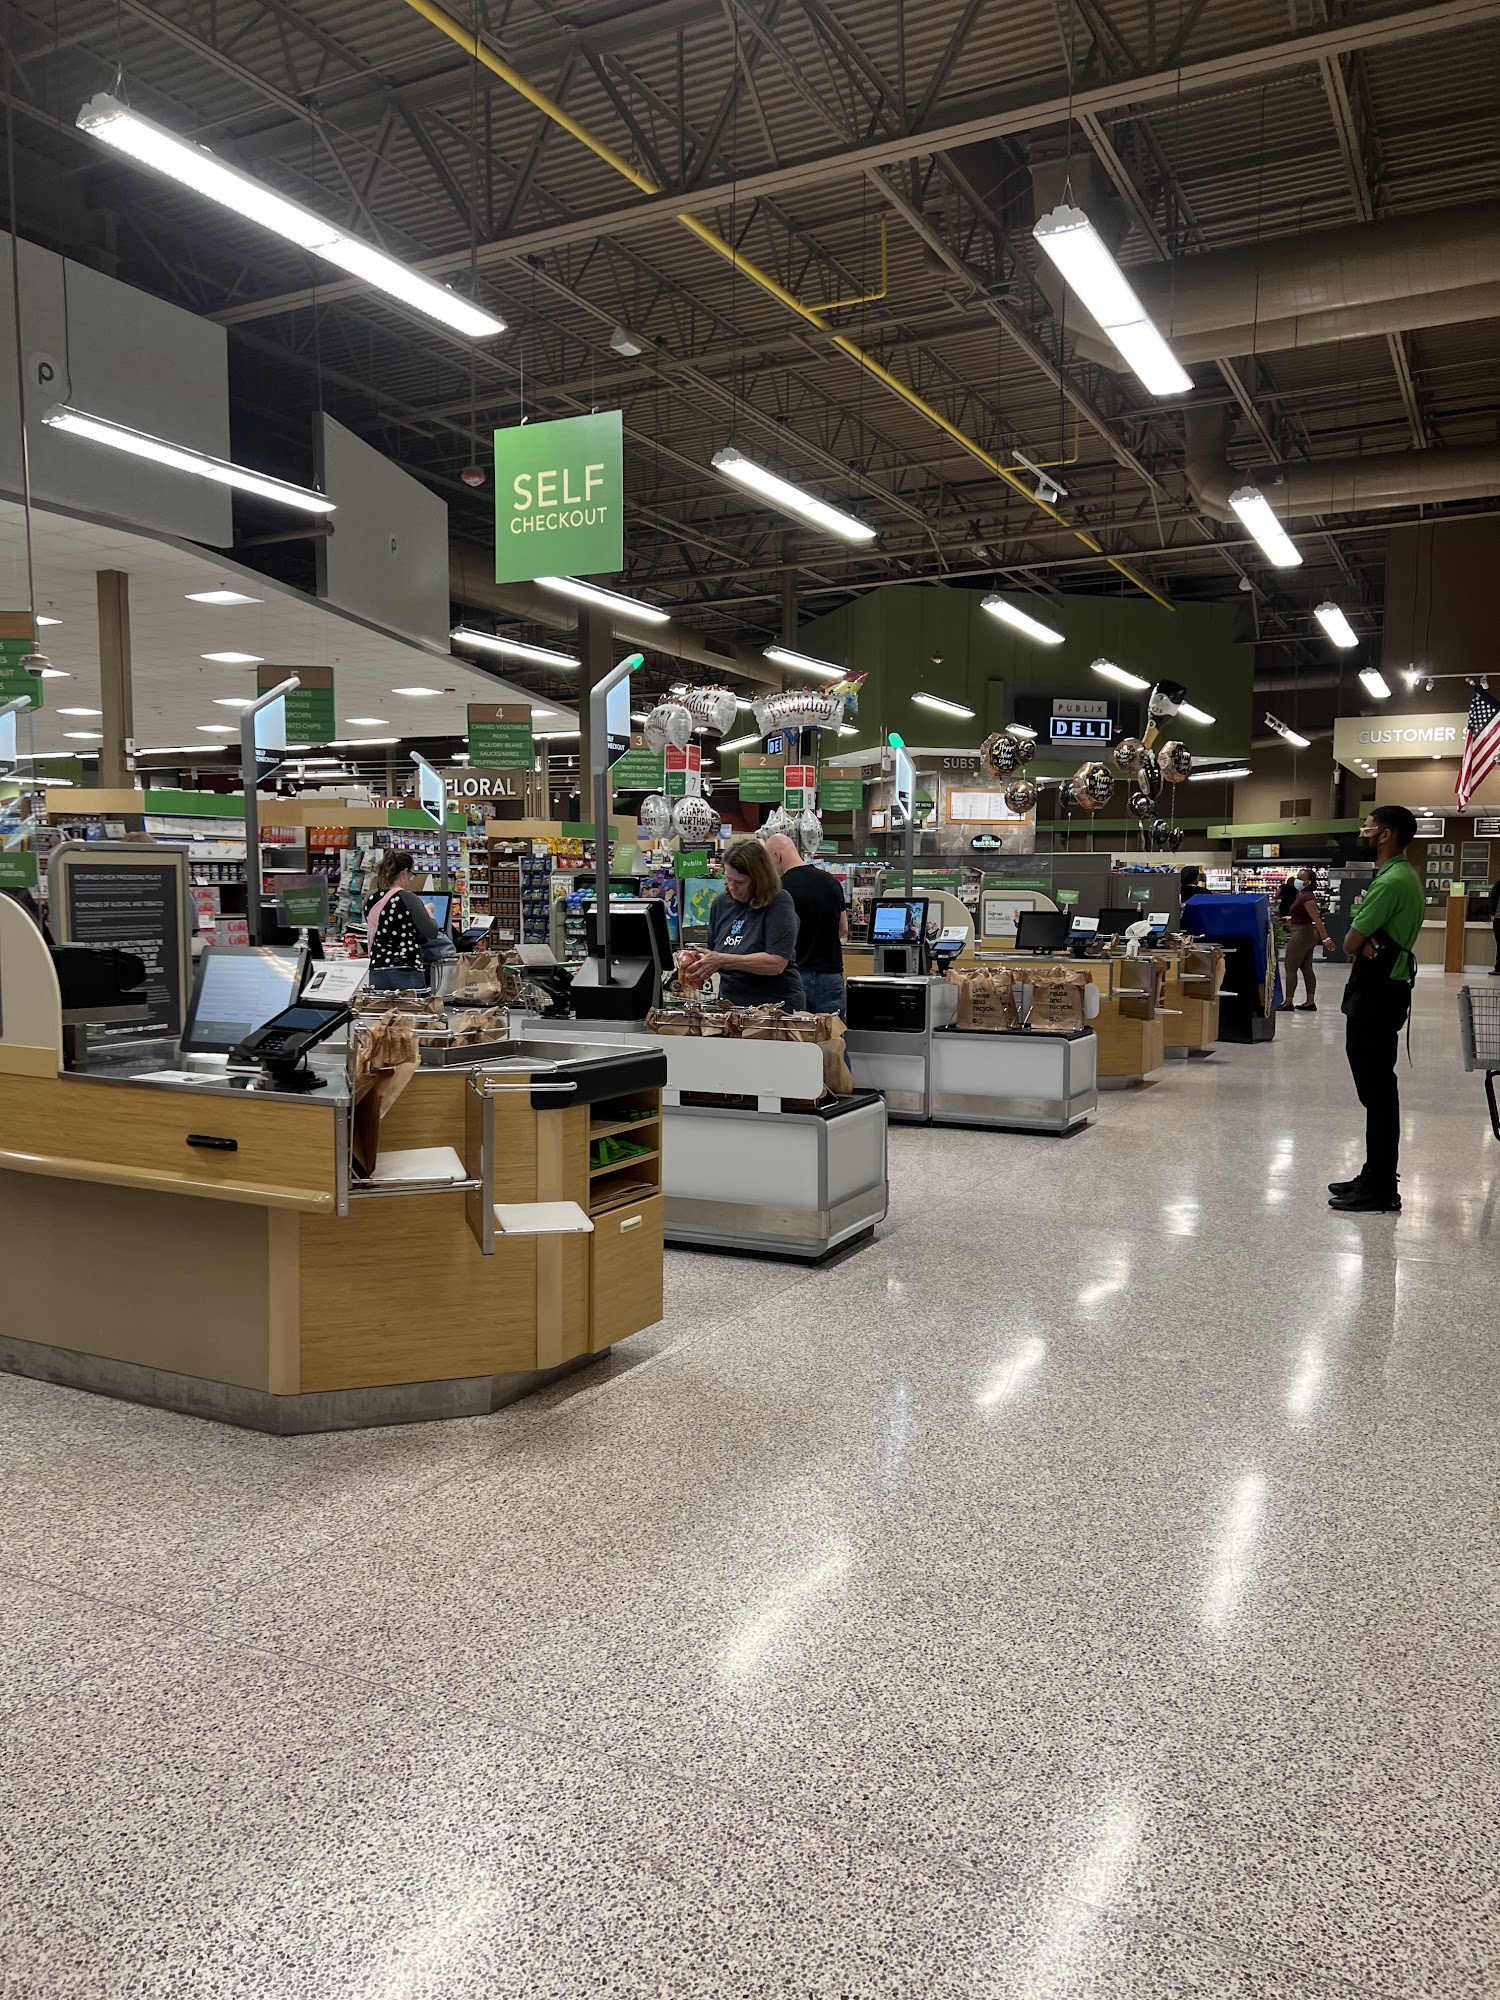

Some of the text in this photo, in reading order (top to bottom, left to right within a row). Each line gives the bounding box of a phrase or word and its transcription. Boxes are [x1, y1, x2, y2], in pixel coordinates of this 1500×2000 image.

[513, 463, 604, 511] SELF
[510, 507, 607, 534] CHECKOUT
[495, 707, 504, 719] 4
[1058, 704, 1103, 713] PUBLIX
[1056, 721, 1106, 736] DELI
[635, 735, 643, 746] 3
[1358, 726, 1456, 744] CUSTOMER
[760, 757, 767, 765] 2
[943, 757, 975, 769] SUBS
[839, 769, 844, 777] 1
[445, 777, 517, 797] FLORAL
[691, 777, 697, 791] 7
[370, 799, 405, 809] DUCE
[808, 793, 812, 806] 8
[723, 935, 743, 946] SoFi
